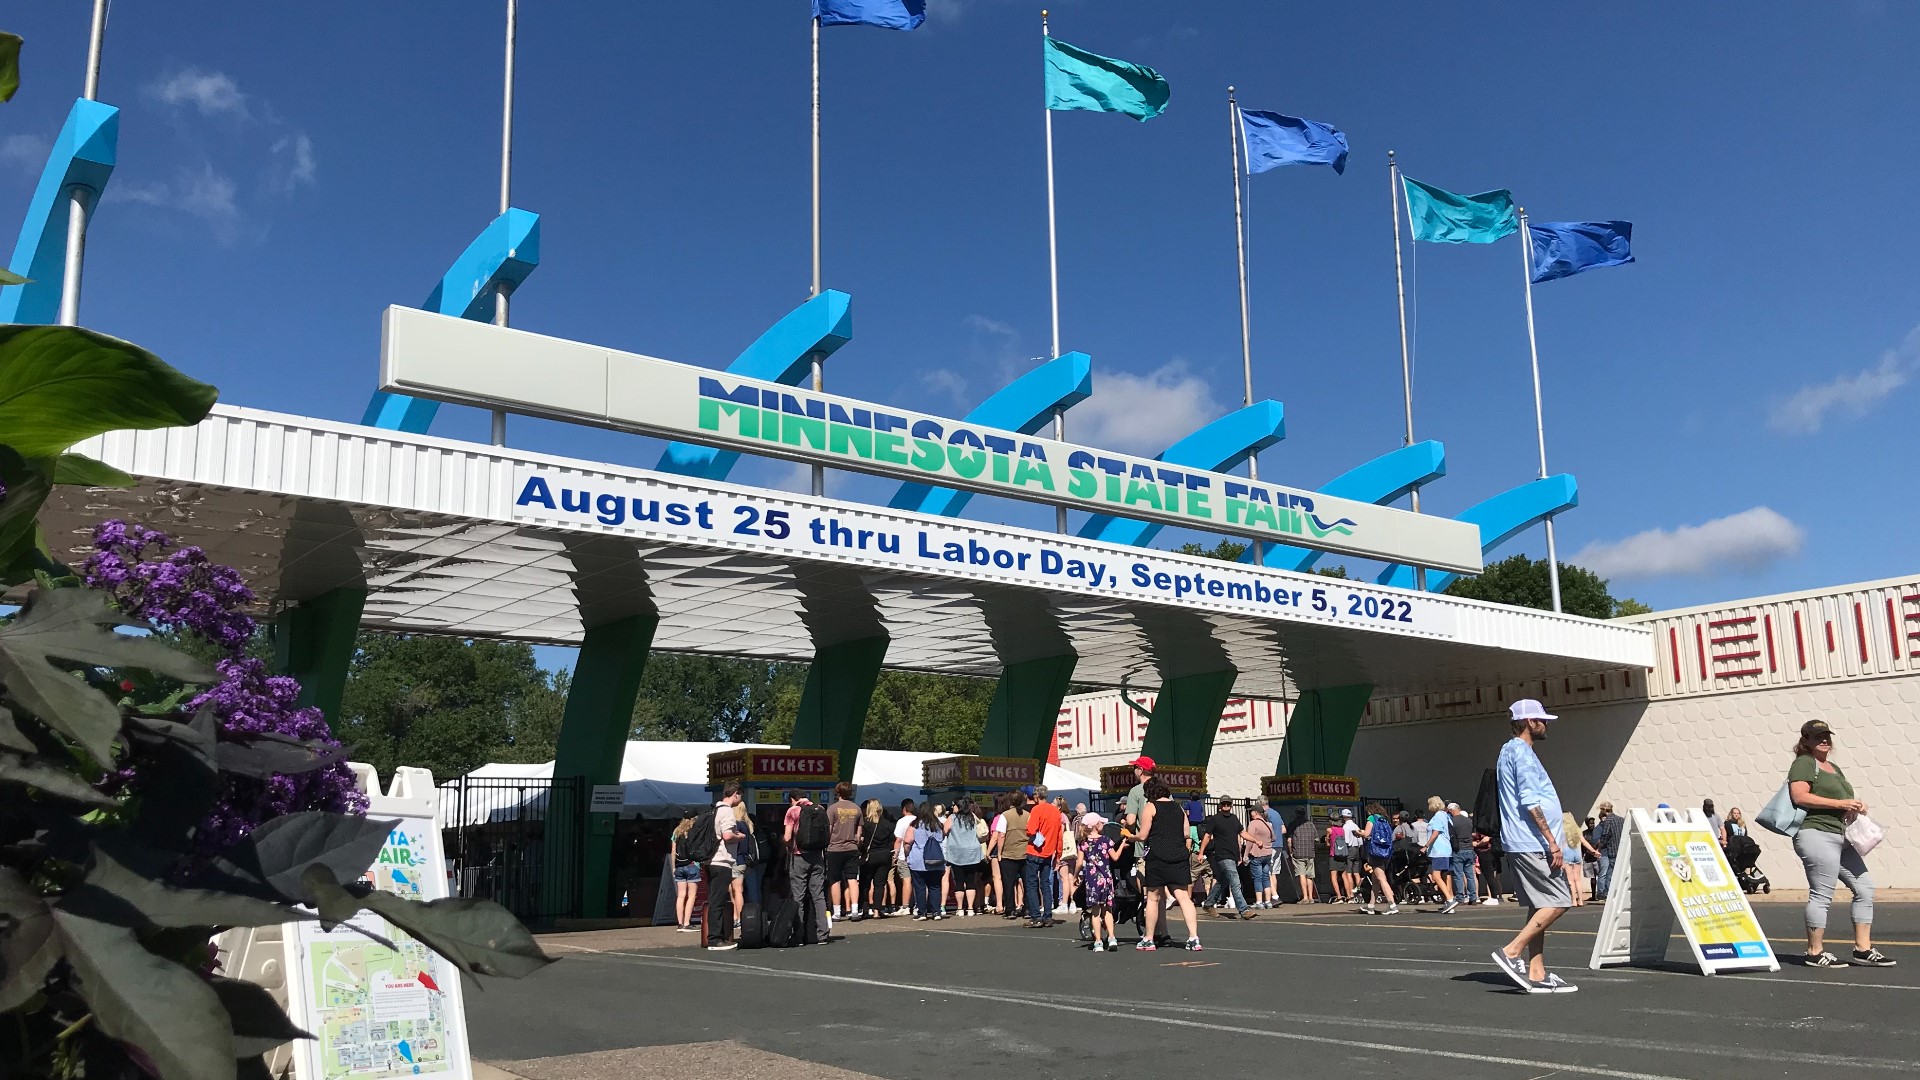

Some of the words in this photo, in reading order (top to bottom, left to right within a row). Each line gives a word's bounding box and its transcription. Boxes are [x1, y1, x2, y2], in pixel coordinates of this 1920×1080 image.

[698, 376, 1056, 492] MINNESOTA
[1067, 450, 1213, 519] STATE
[1225, 481, 1322, 537] FAIR
[515, 476, 714, 530] August
[732, 505, 791, 540] 25
[809, 517, 900, 554] thru
[918, 531, 1032, 571] Labor
[1040, 549, 1117, 587] Day,
[1131, 563, 1303, 607] September
[1311, 588, 1337, 617] 5,
[1347, 593, 1413, 623] 2022
[716, 760, 743, 775] TICKETS
[760, 758, 825, 773] TICKETS
[930, 765, 961, 780] TICKETS
[975, 765, 1028, 779] TICKETS
[1269, 782, 1300, 794] TICKETS
[1313, 782, 1351, 794] TICKETS
[380, 847, 412, 864] AIR
[1681, 894, 1709, 907] SAVE
[1709, 890, 1739, 903] TIME!
[1686, 907, 1709, 920] AVOID
[1709, 904, 1726, 915] THE
